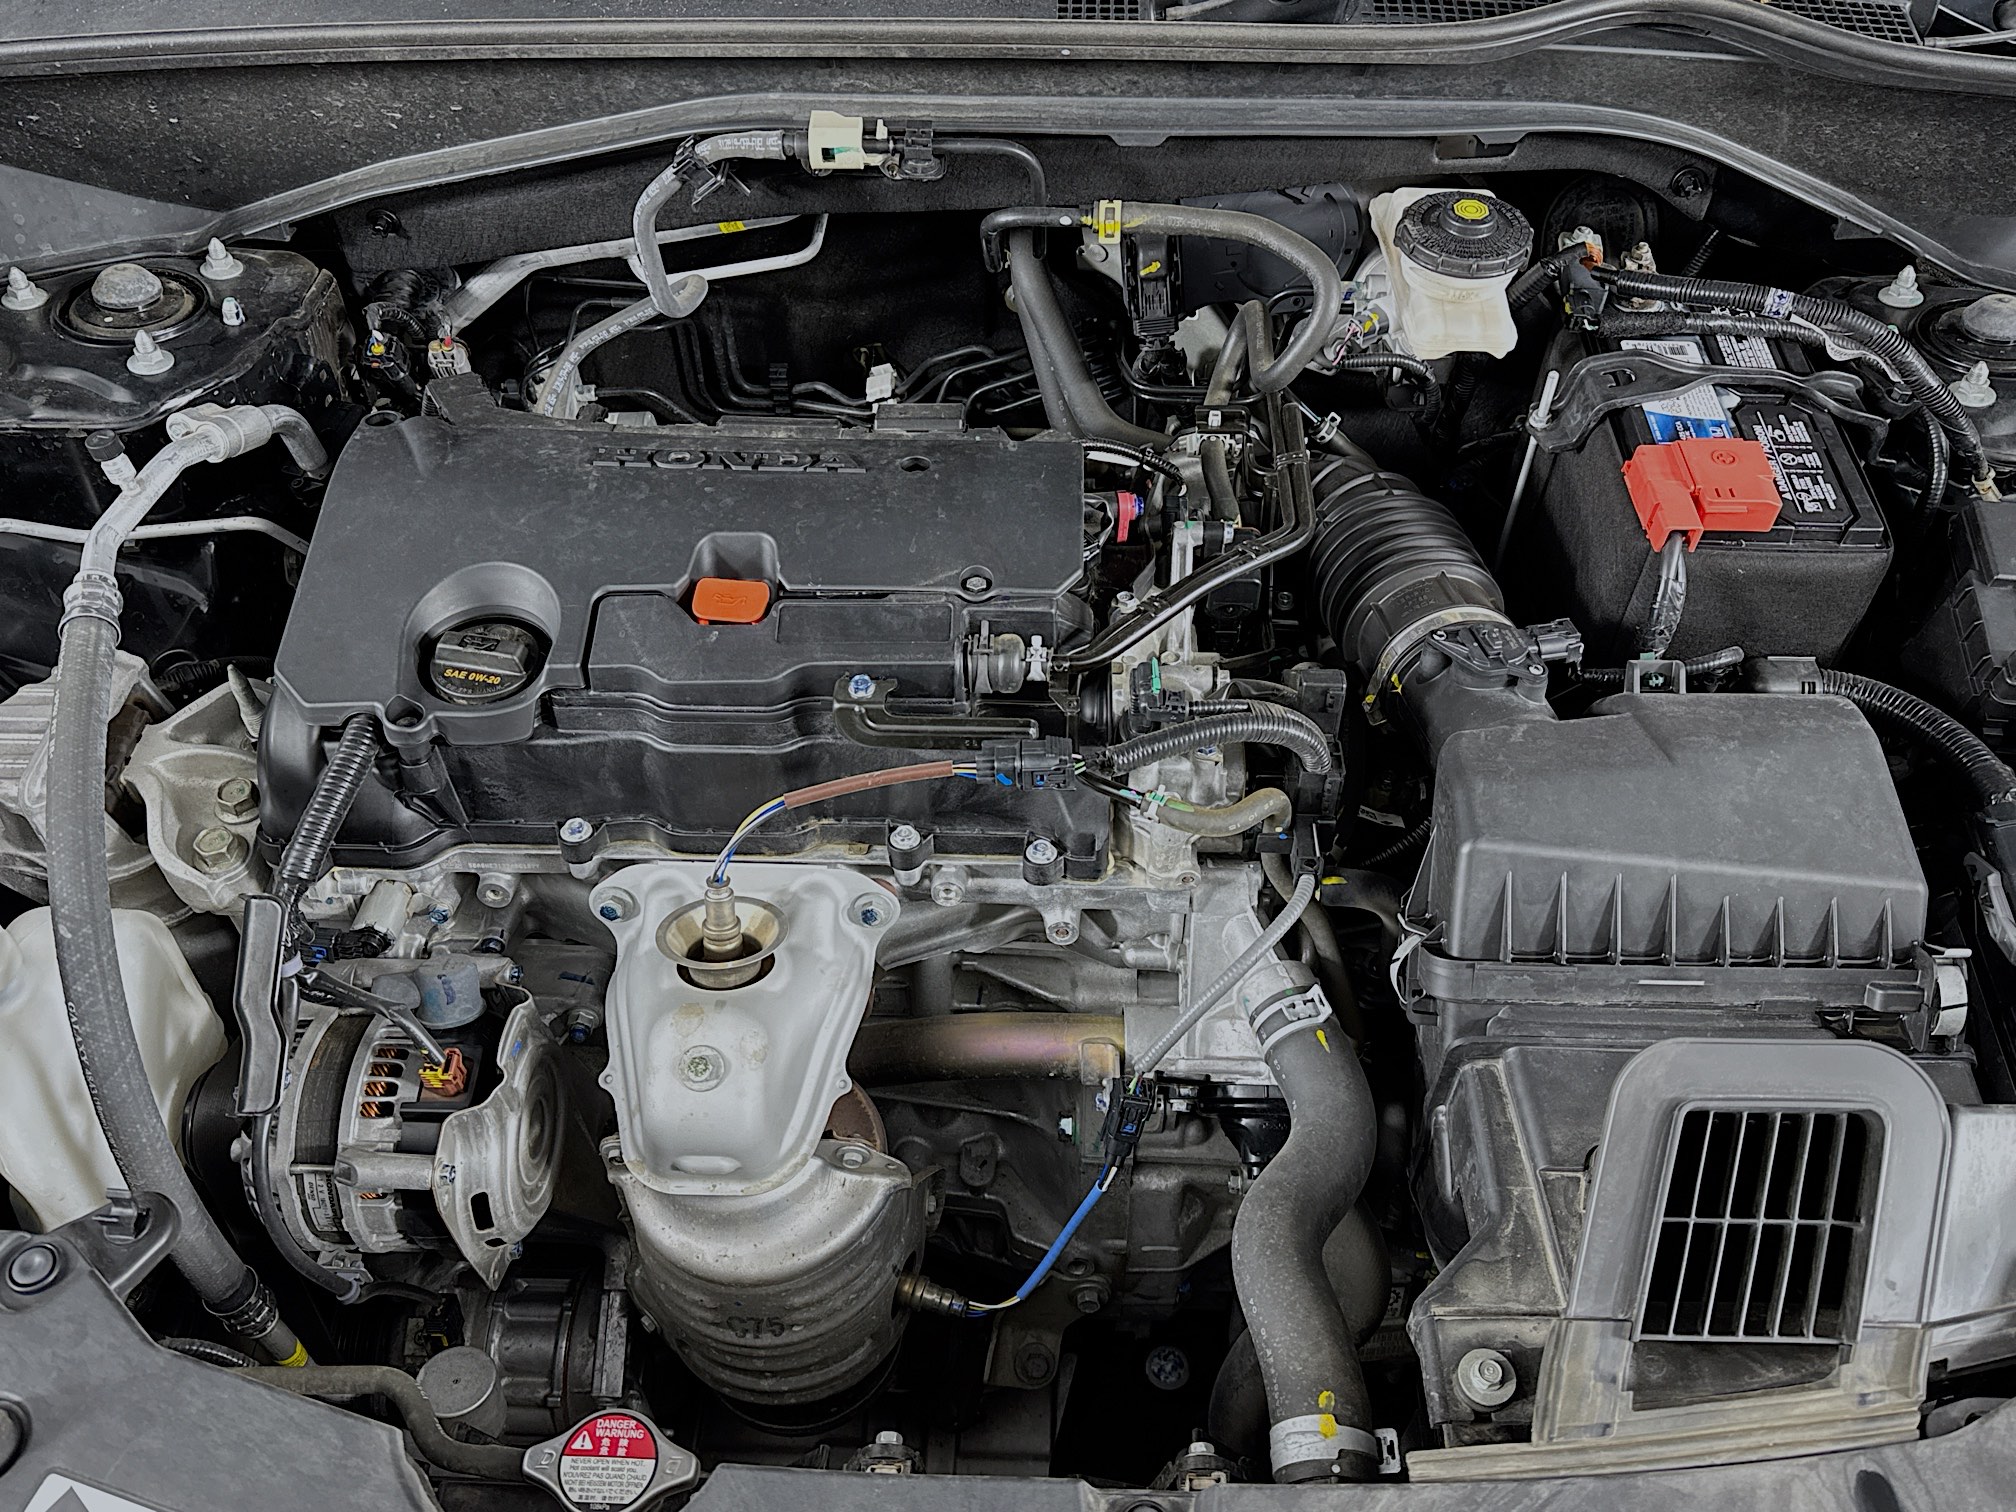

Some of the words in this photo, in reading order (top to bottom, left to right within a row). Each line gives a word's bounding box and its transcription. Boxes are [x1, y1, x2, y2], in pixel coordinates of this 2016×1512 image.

[592, 446, 867, 474] HONDA
[1768, 459, 1790, 492] DANGER
[443, 668, 468, 679] SAE
[468, 672, 502, 685] 0W-20
[67, 1001, 90, 1066] GALAXY
[595, 1428, 645, 1439] WARNUNG
[596, 1418, 637, 1429] DANGER
